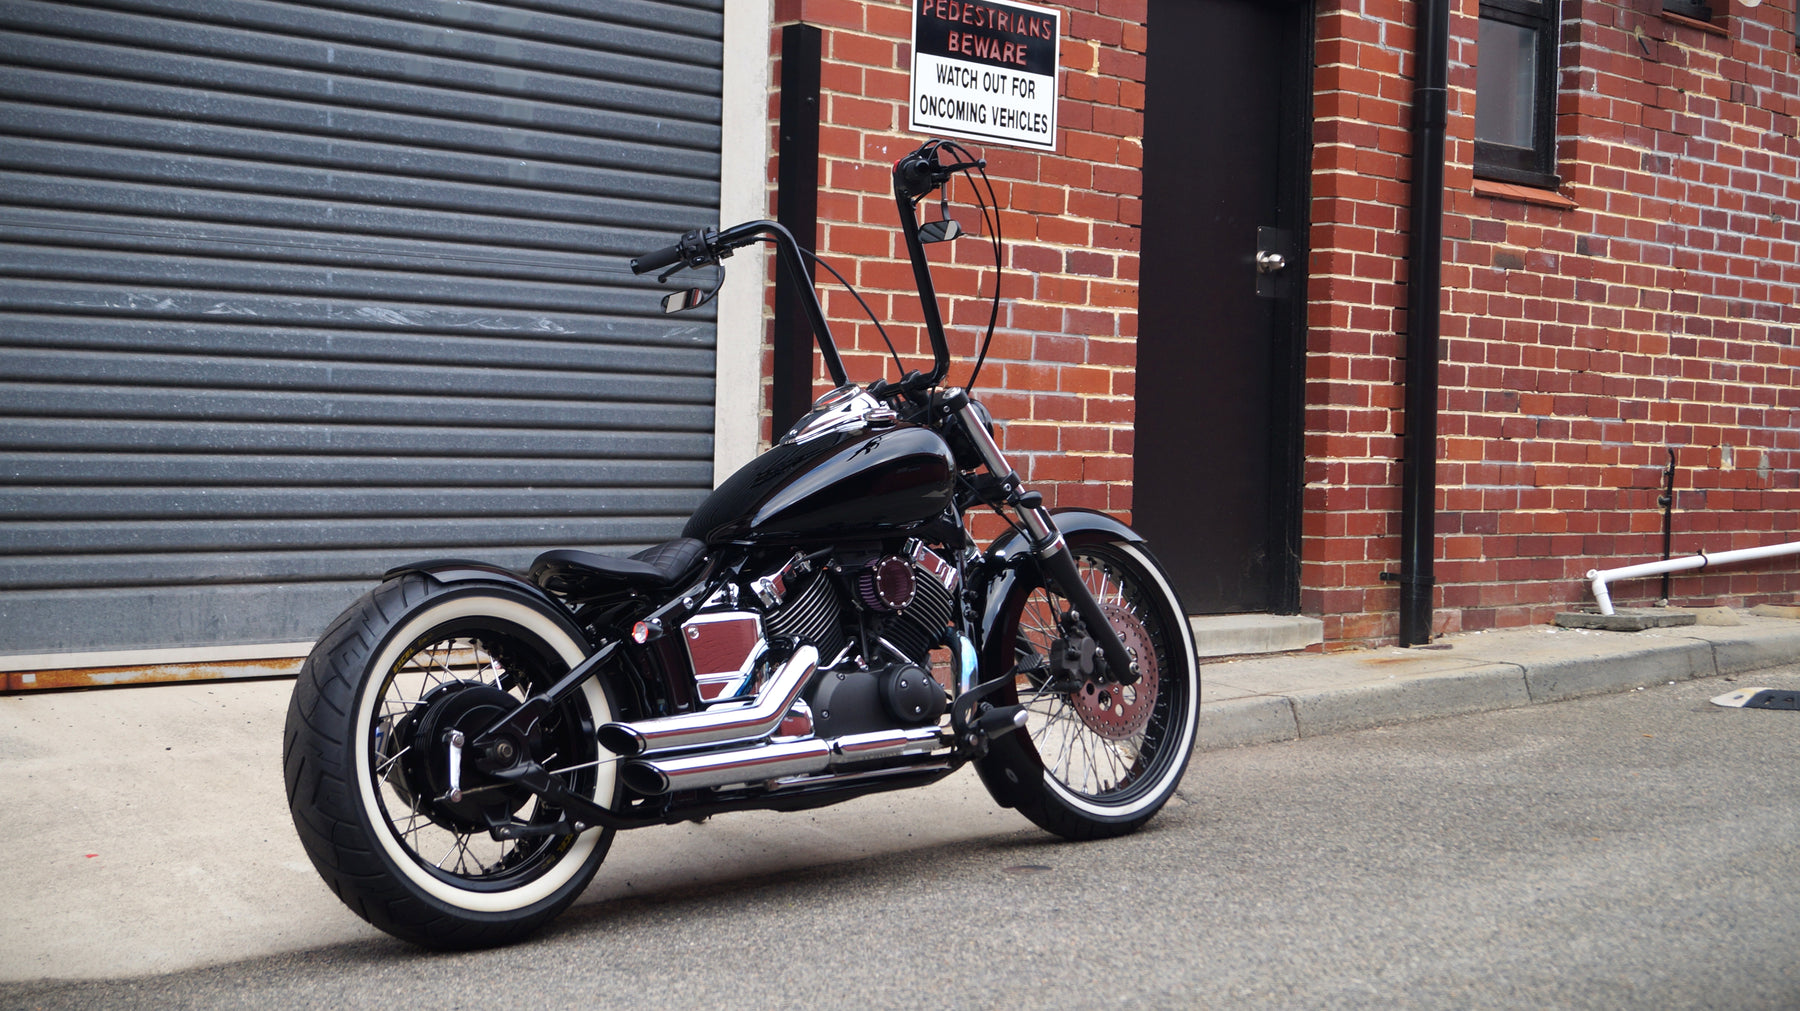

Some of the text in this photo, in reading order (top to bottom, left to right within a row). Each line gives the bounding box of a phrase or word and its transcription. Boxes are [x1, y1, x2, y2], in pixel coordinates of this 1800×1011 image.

[922, 0, 1051, 40] PEDESTRIANS
[948, 31, 1028, 66] BEWARE
[936, 63, 1036, 100] WATCH OUT FOR
[919, 94, 1048, 134] ONCOMING VEHICLES
